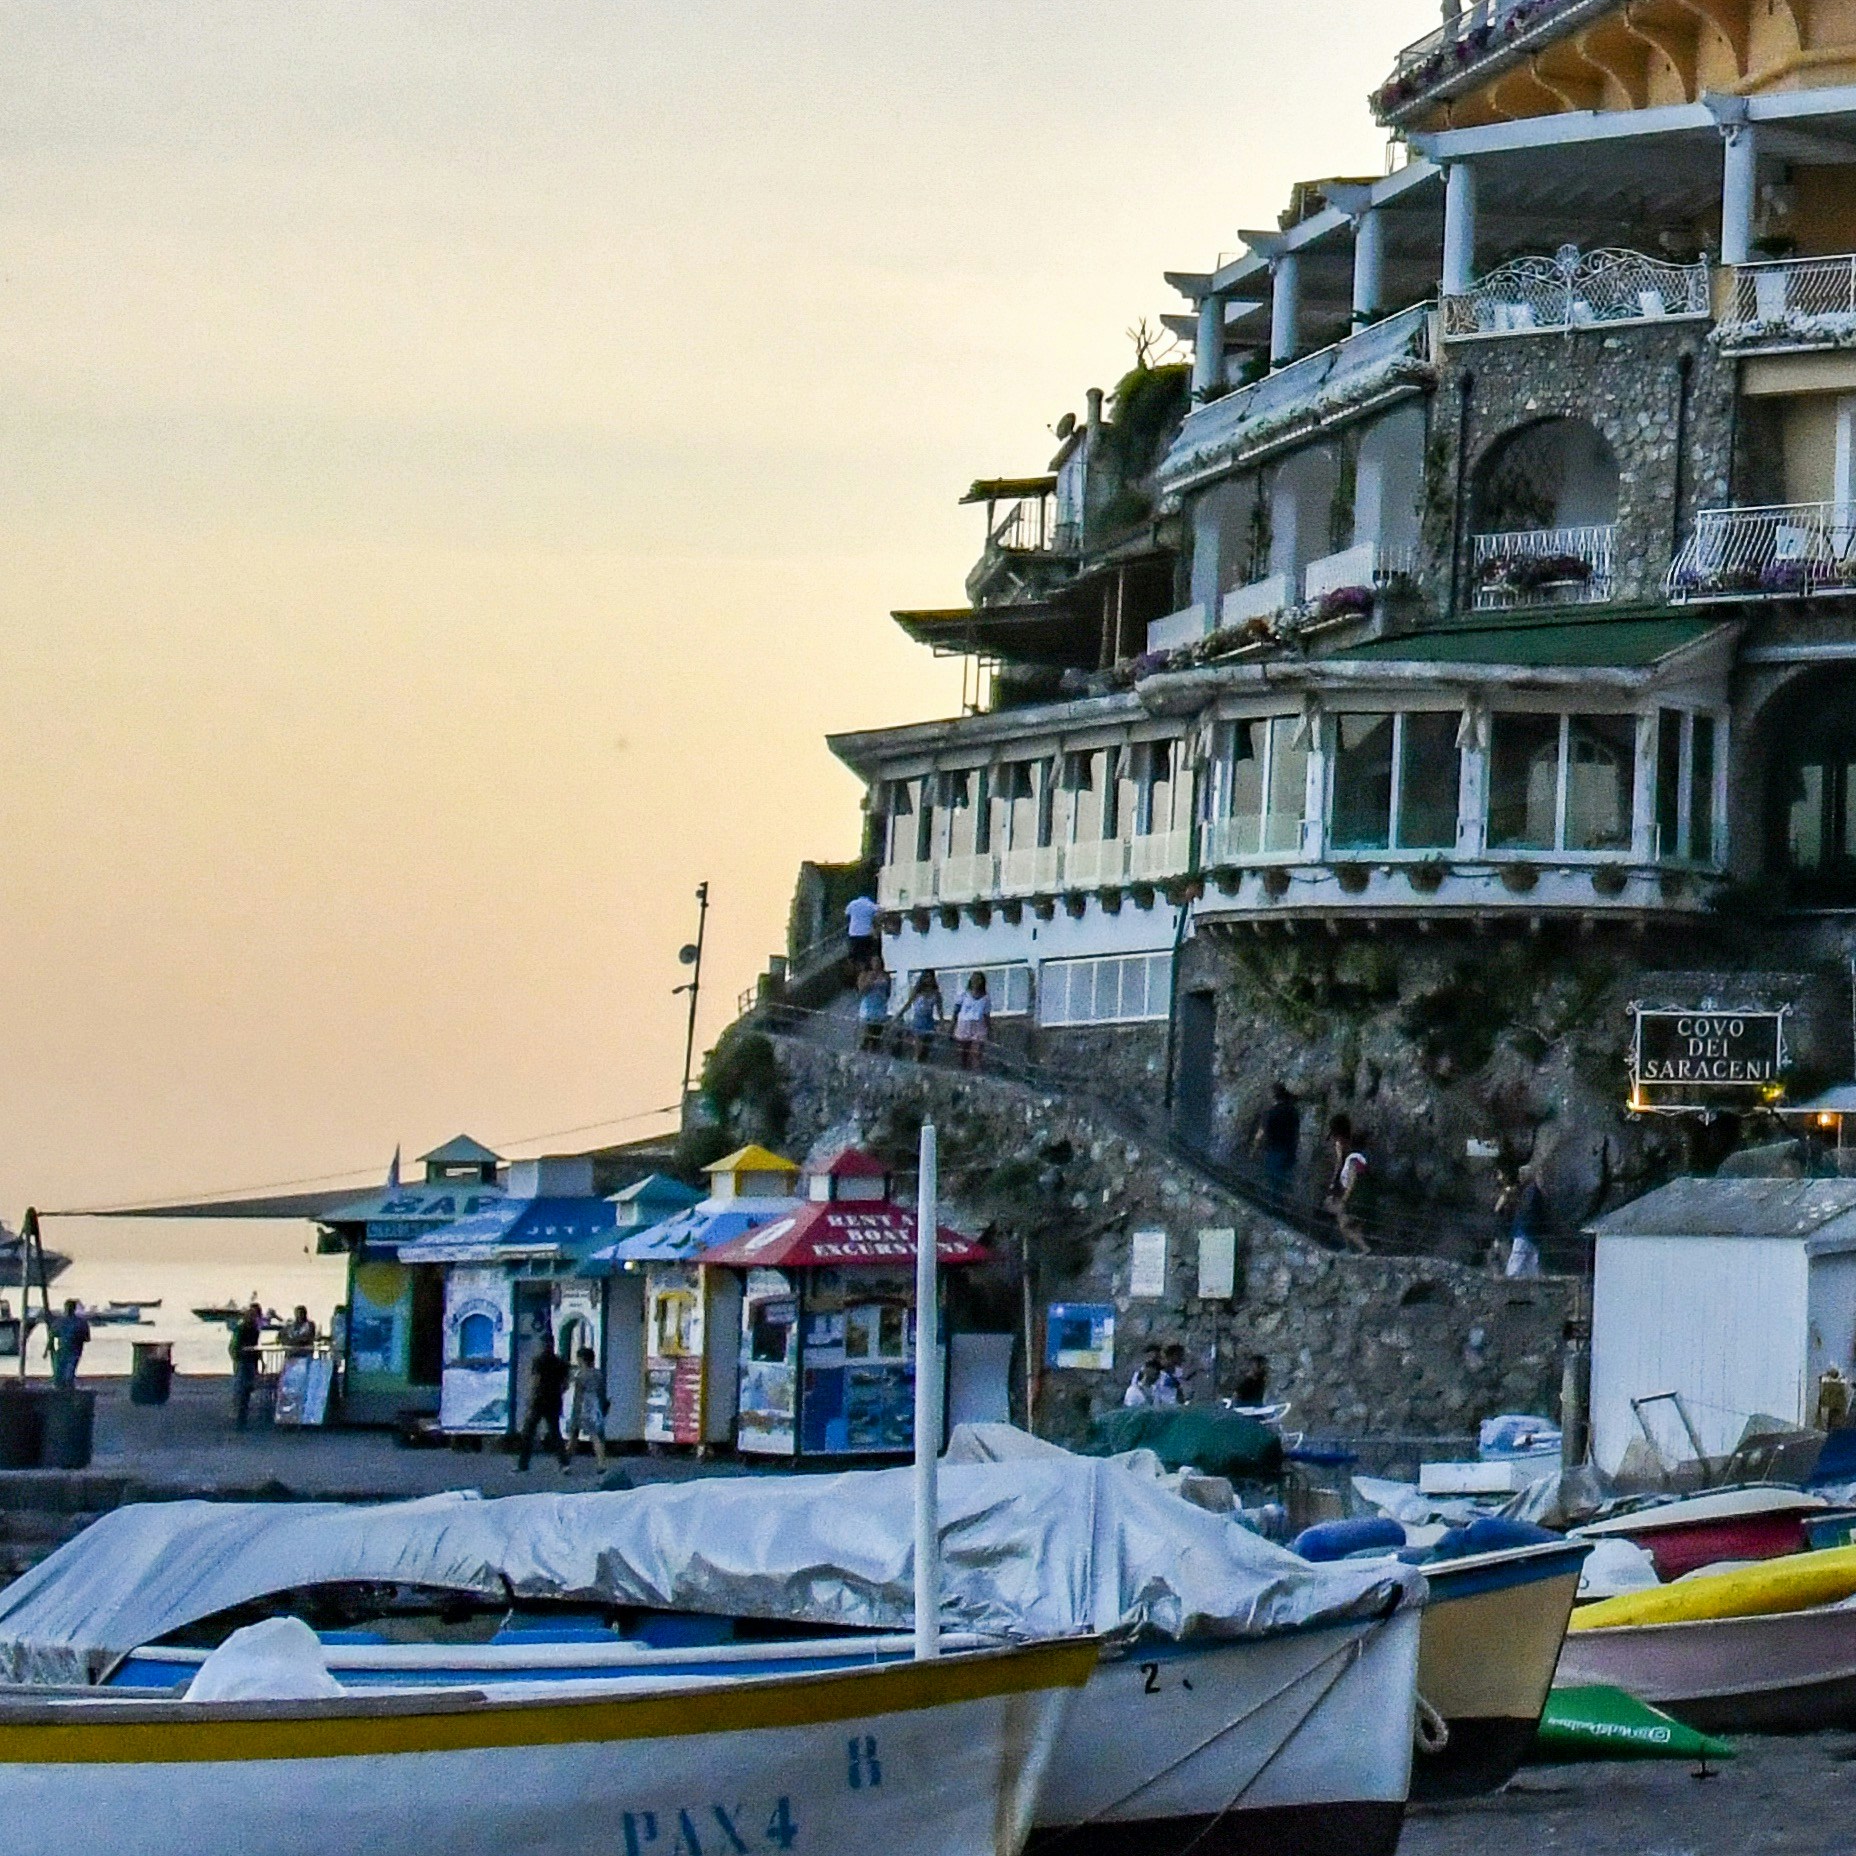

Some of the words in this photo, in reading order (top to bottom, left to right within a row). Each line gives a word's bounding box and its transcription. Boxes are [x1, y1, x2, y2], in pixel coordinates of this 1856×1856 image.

[1677, 1017, 1744, 1038] COVO
[1688, 1038, 1728, 1058] DEI
[1644, 1059, 1770, 1080] SARACENI
[827, 1214, 891, 1227] RENT
[846, 1229, 911, 1242] BOAT
[766, 1796, 799, 1849] 4
